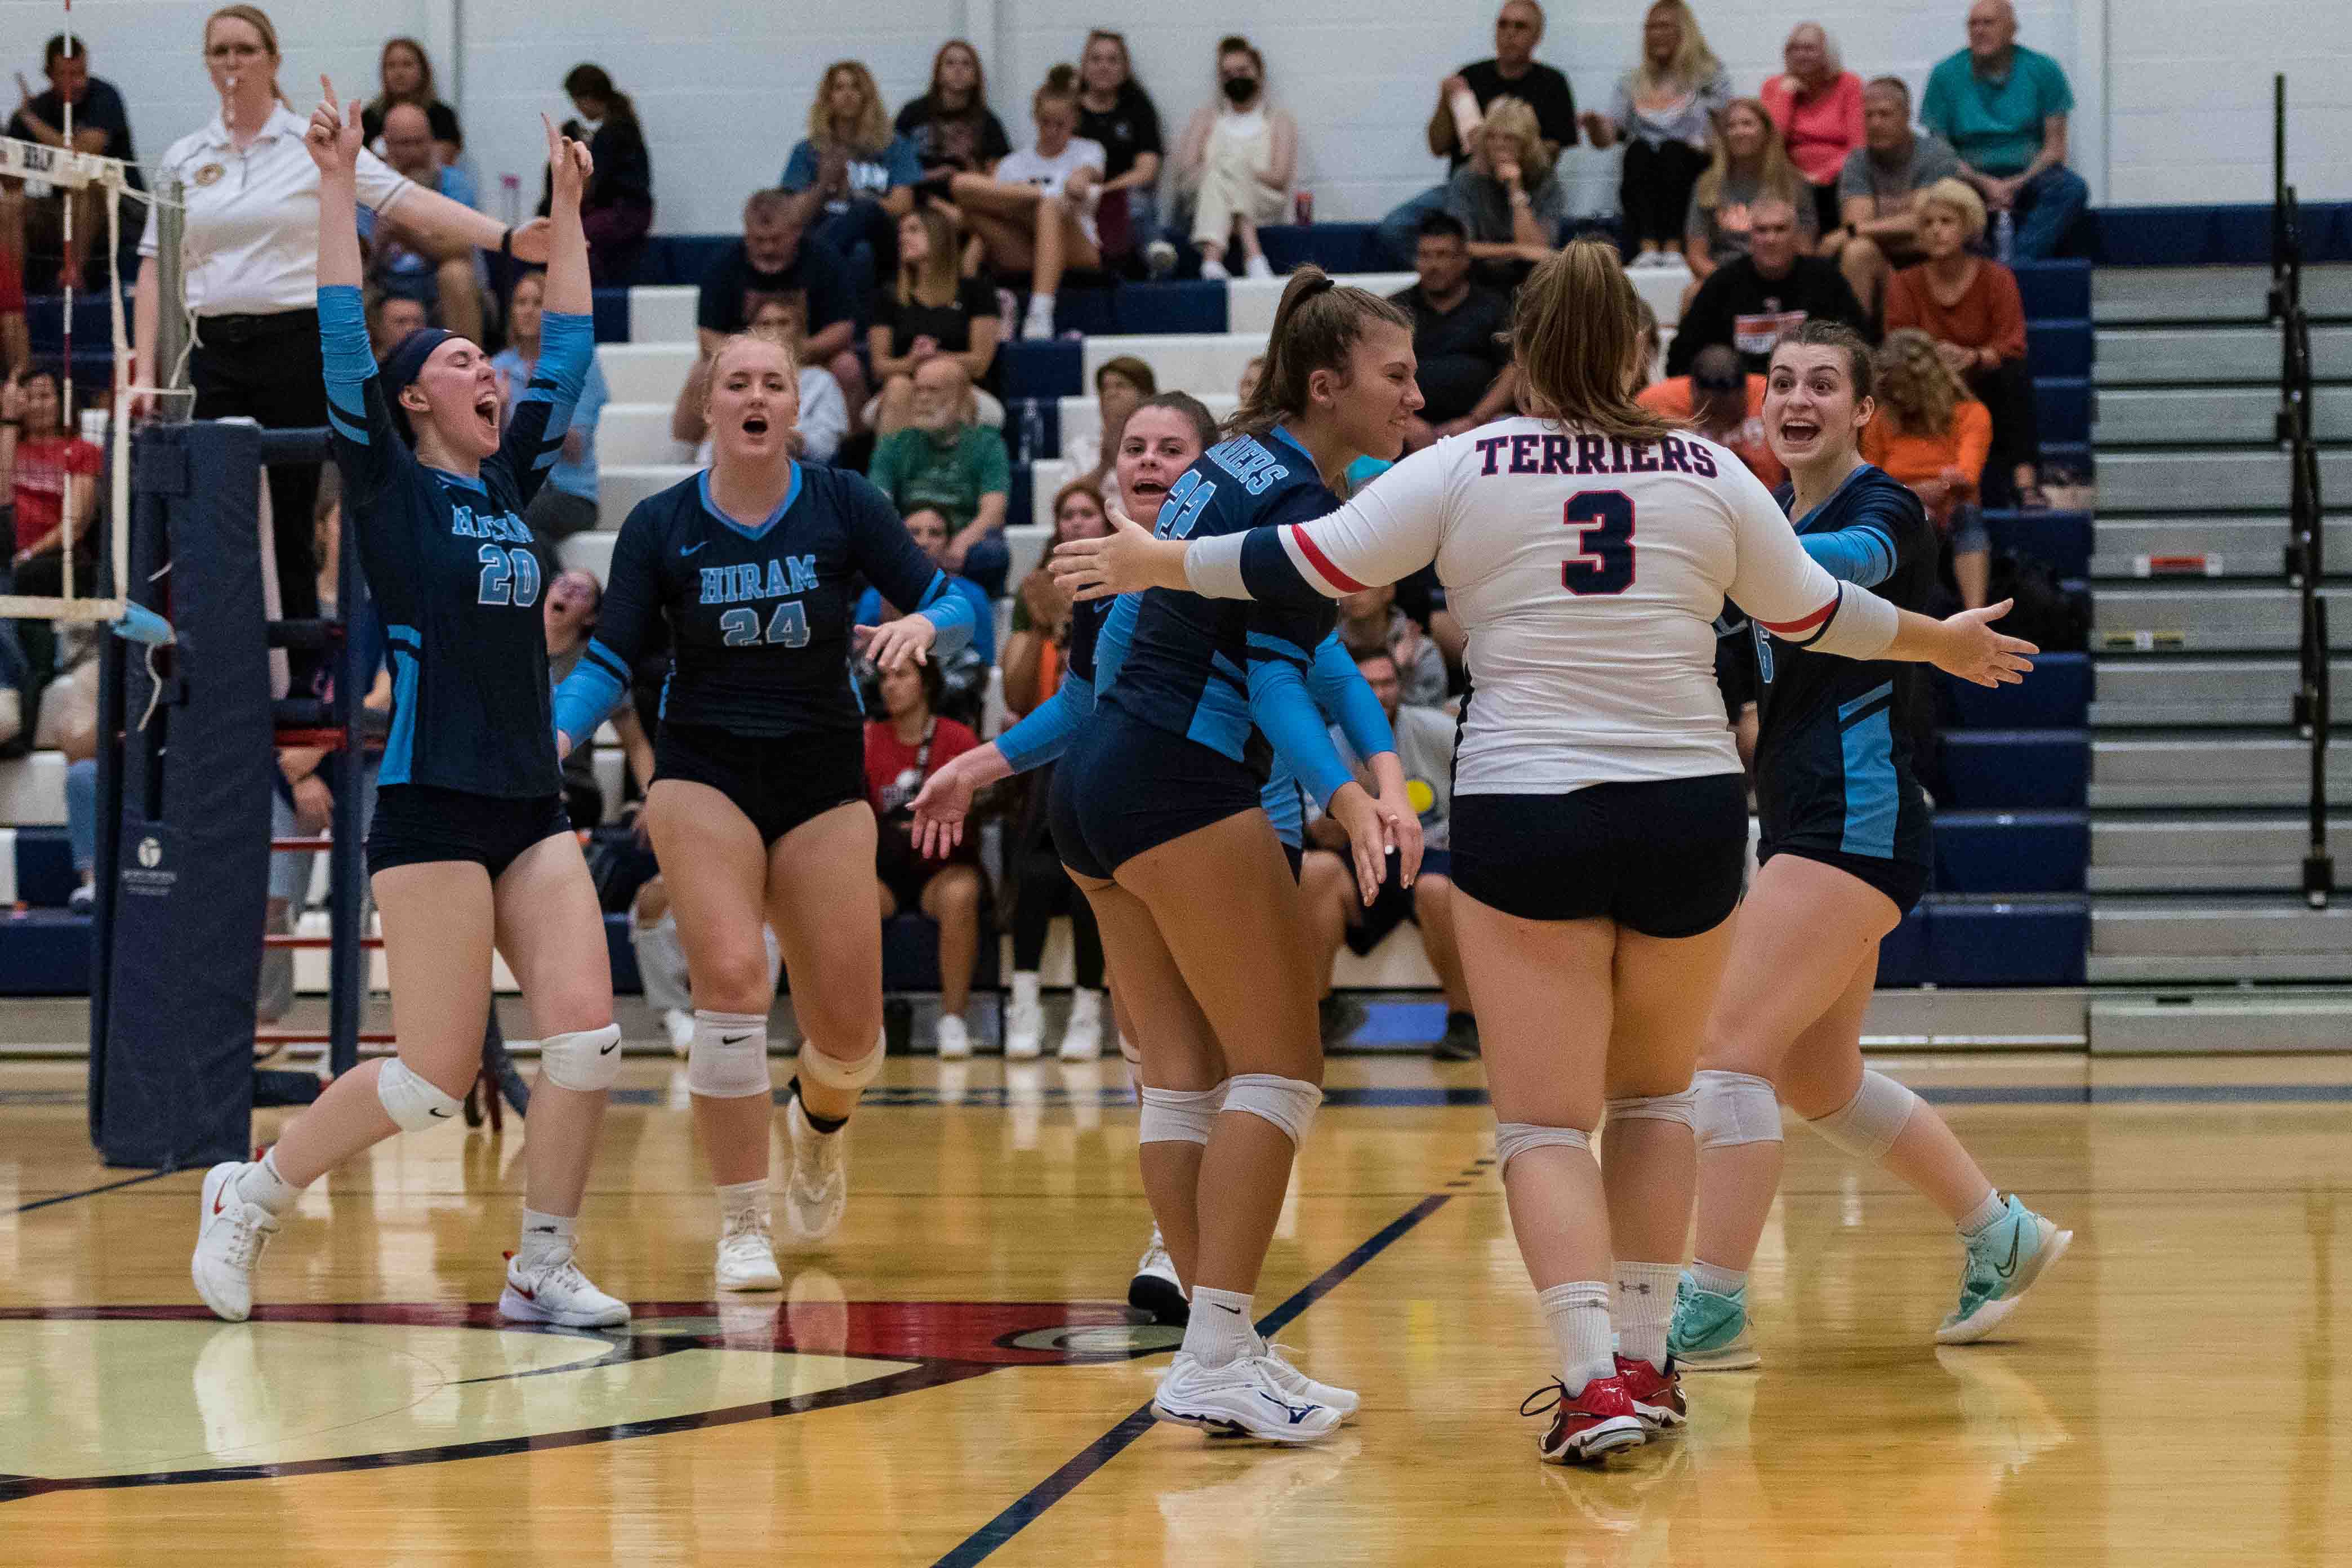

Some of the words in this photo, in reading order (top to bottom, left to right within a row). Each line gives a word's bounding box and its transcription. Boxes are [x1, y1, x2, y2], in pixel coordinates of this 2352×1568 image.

[1475, 434, 1718, 478] TERRIERS
[1561, 489, 1636, 595] 3
[478, 544, 541, 608] 20
[699, 554, 820, 604] HIRAM
[719, 600, 811, 648] 24
